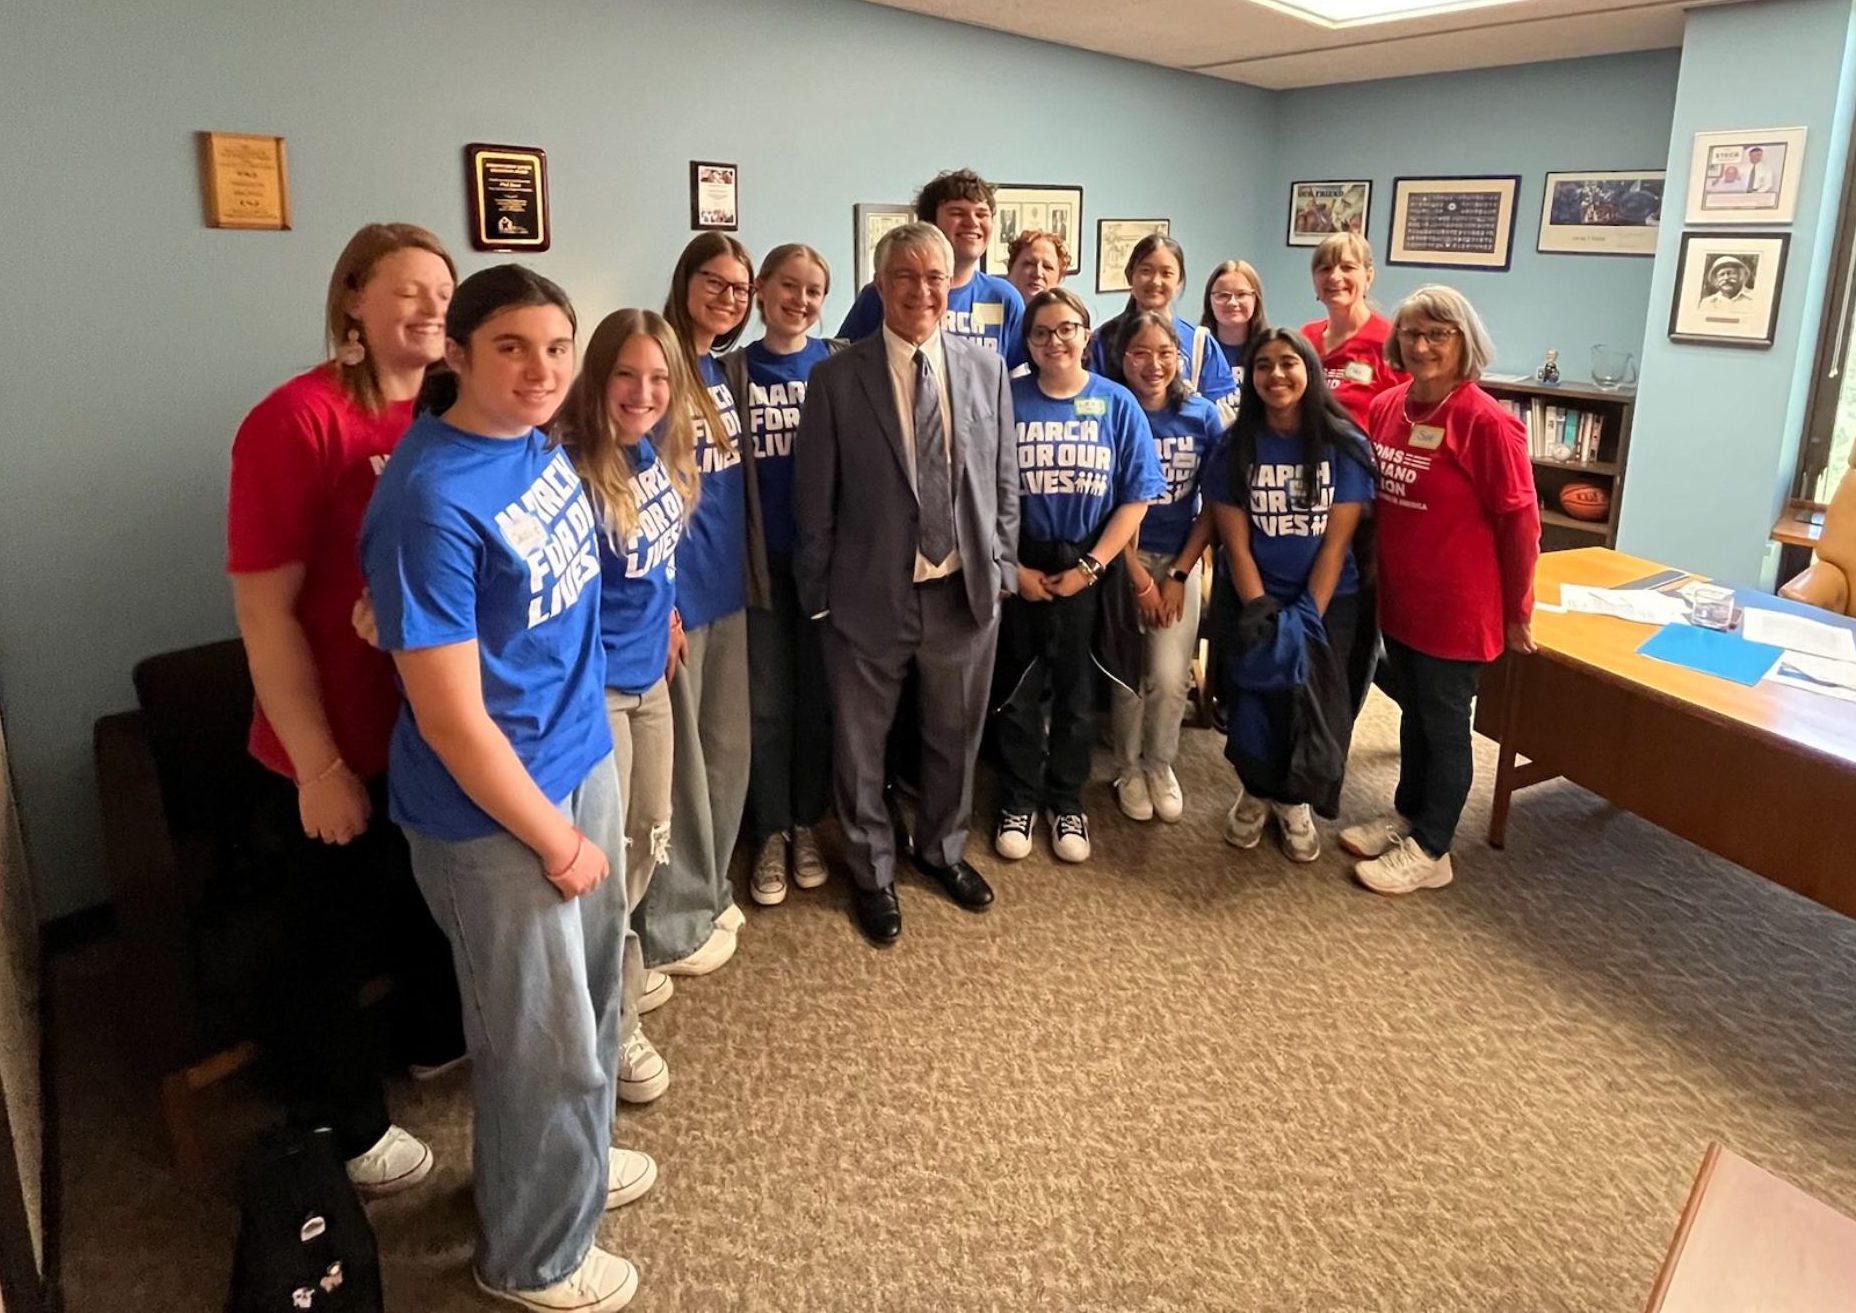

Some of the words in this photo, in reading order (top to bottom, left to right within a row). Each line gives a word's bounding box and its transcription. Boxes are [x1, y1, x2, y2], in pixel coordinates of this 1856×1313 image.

[749, 381, 807, 406] MAR
[750, 407, 800, 433] FOR
[752, 431, 796, 458] LIV
[1018, 443, 1054, 468] OR
[1058, 444, 1111, 470] OUR
[1374, 442, 1404, 463] OMS
[1250, 489, 1288, 513] OR
[526, 519, 579, 594] FOR
[528, 540, 600, 629] LIVES
